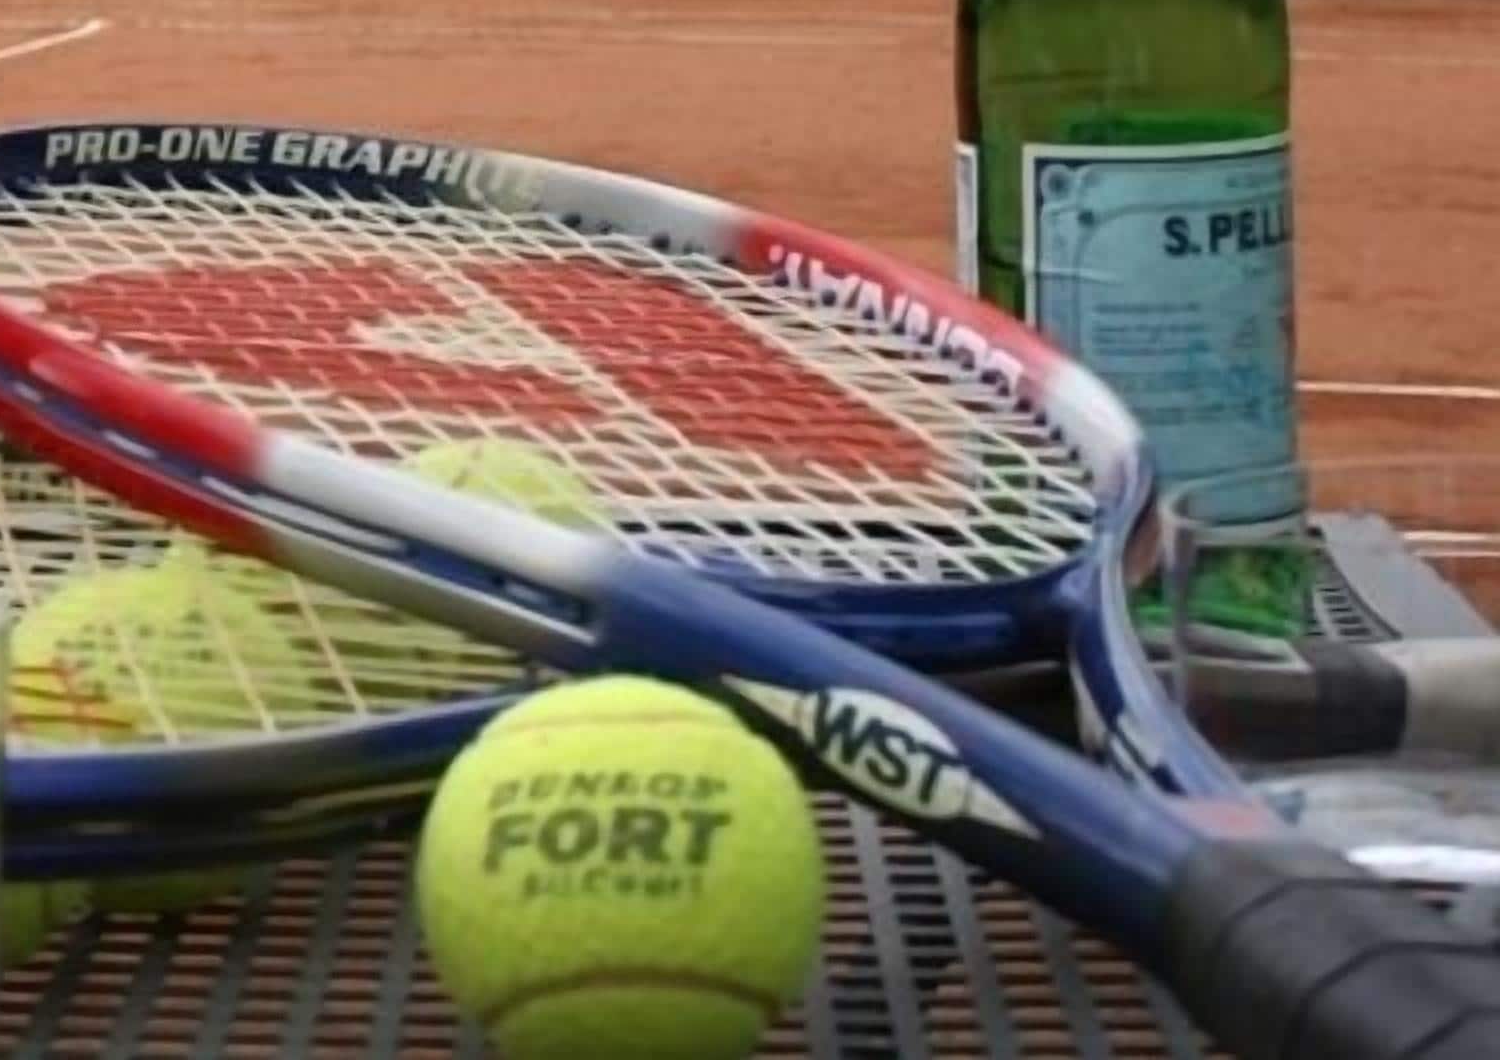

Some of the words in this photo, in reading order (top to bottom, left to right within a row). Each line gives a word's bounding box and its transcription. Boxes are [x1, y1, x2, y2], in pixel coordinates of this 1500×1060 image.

[45, 127, 261, 168] PRO-ONE
[812, 690, 963, 805] WST
[482, 807, 733, 875] FORT
